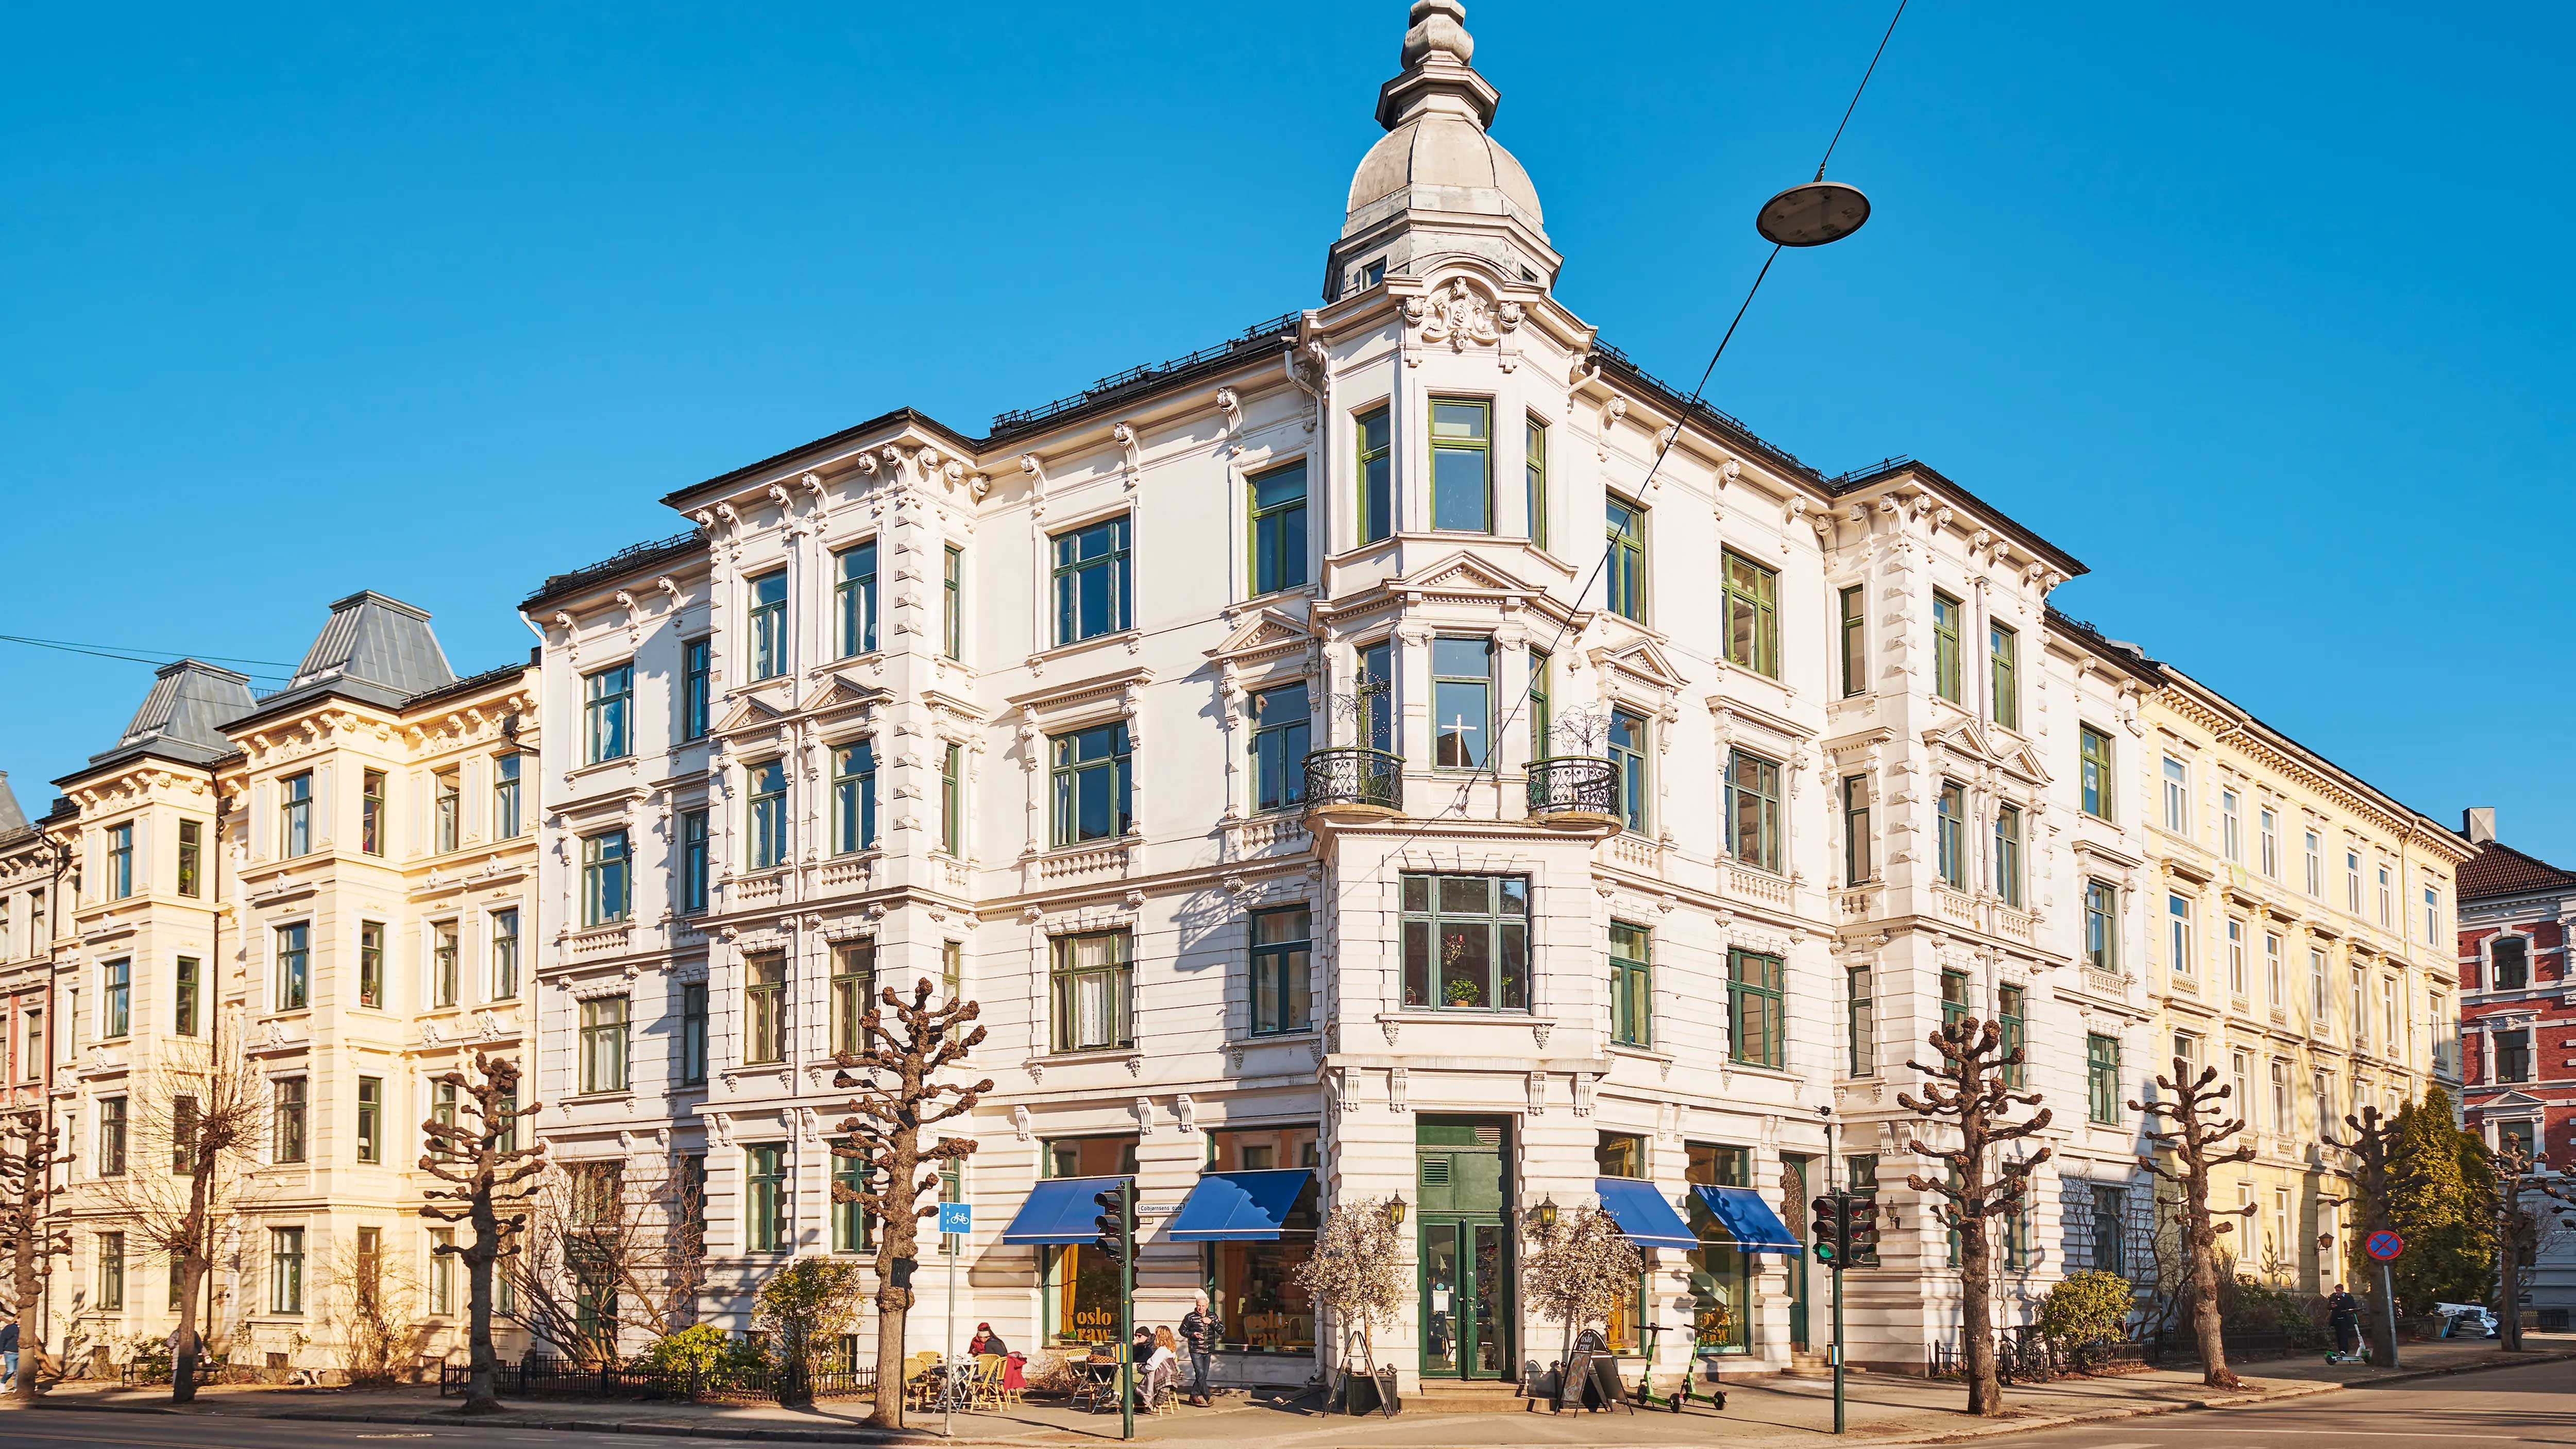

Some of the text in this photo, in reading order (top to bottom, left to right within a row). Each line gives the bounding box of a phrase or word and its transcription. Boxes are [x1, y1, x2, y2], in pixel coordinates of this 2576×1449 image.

[1077, 1307, 1112, 1325] oslo
[1246, 1310, 1285, 1328] oslo
[1076, 1328, 1111, 1341] raw
[1248, 1333, 1283, 1346] raw
[1581, 1334, 1592, 1343] oslo
